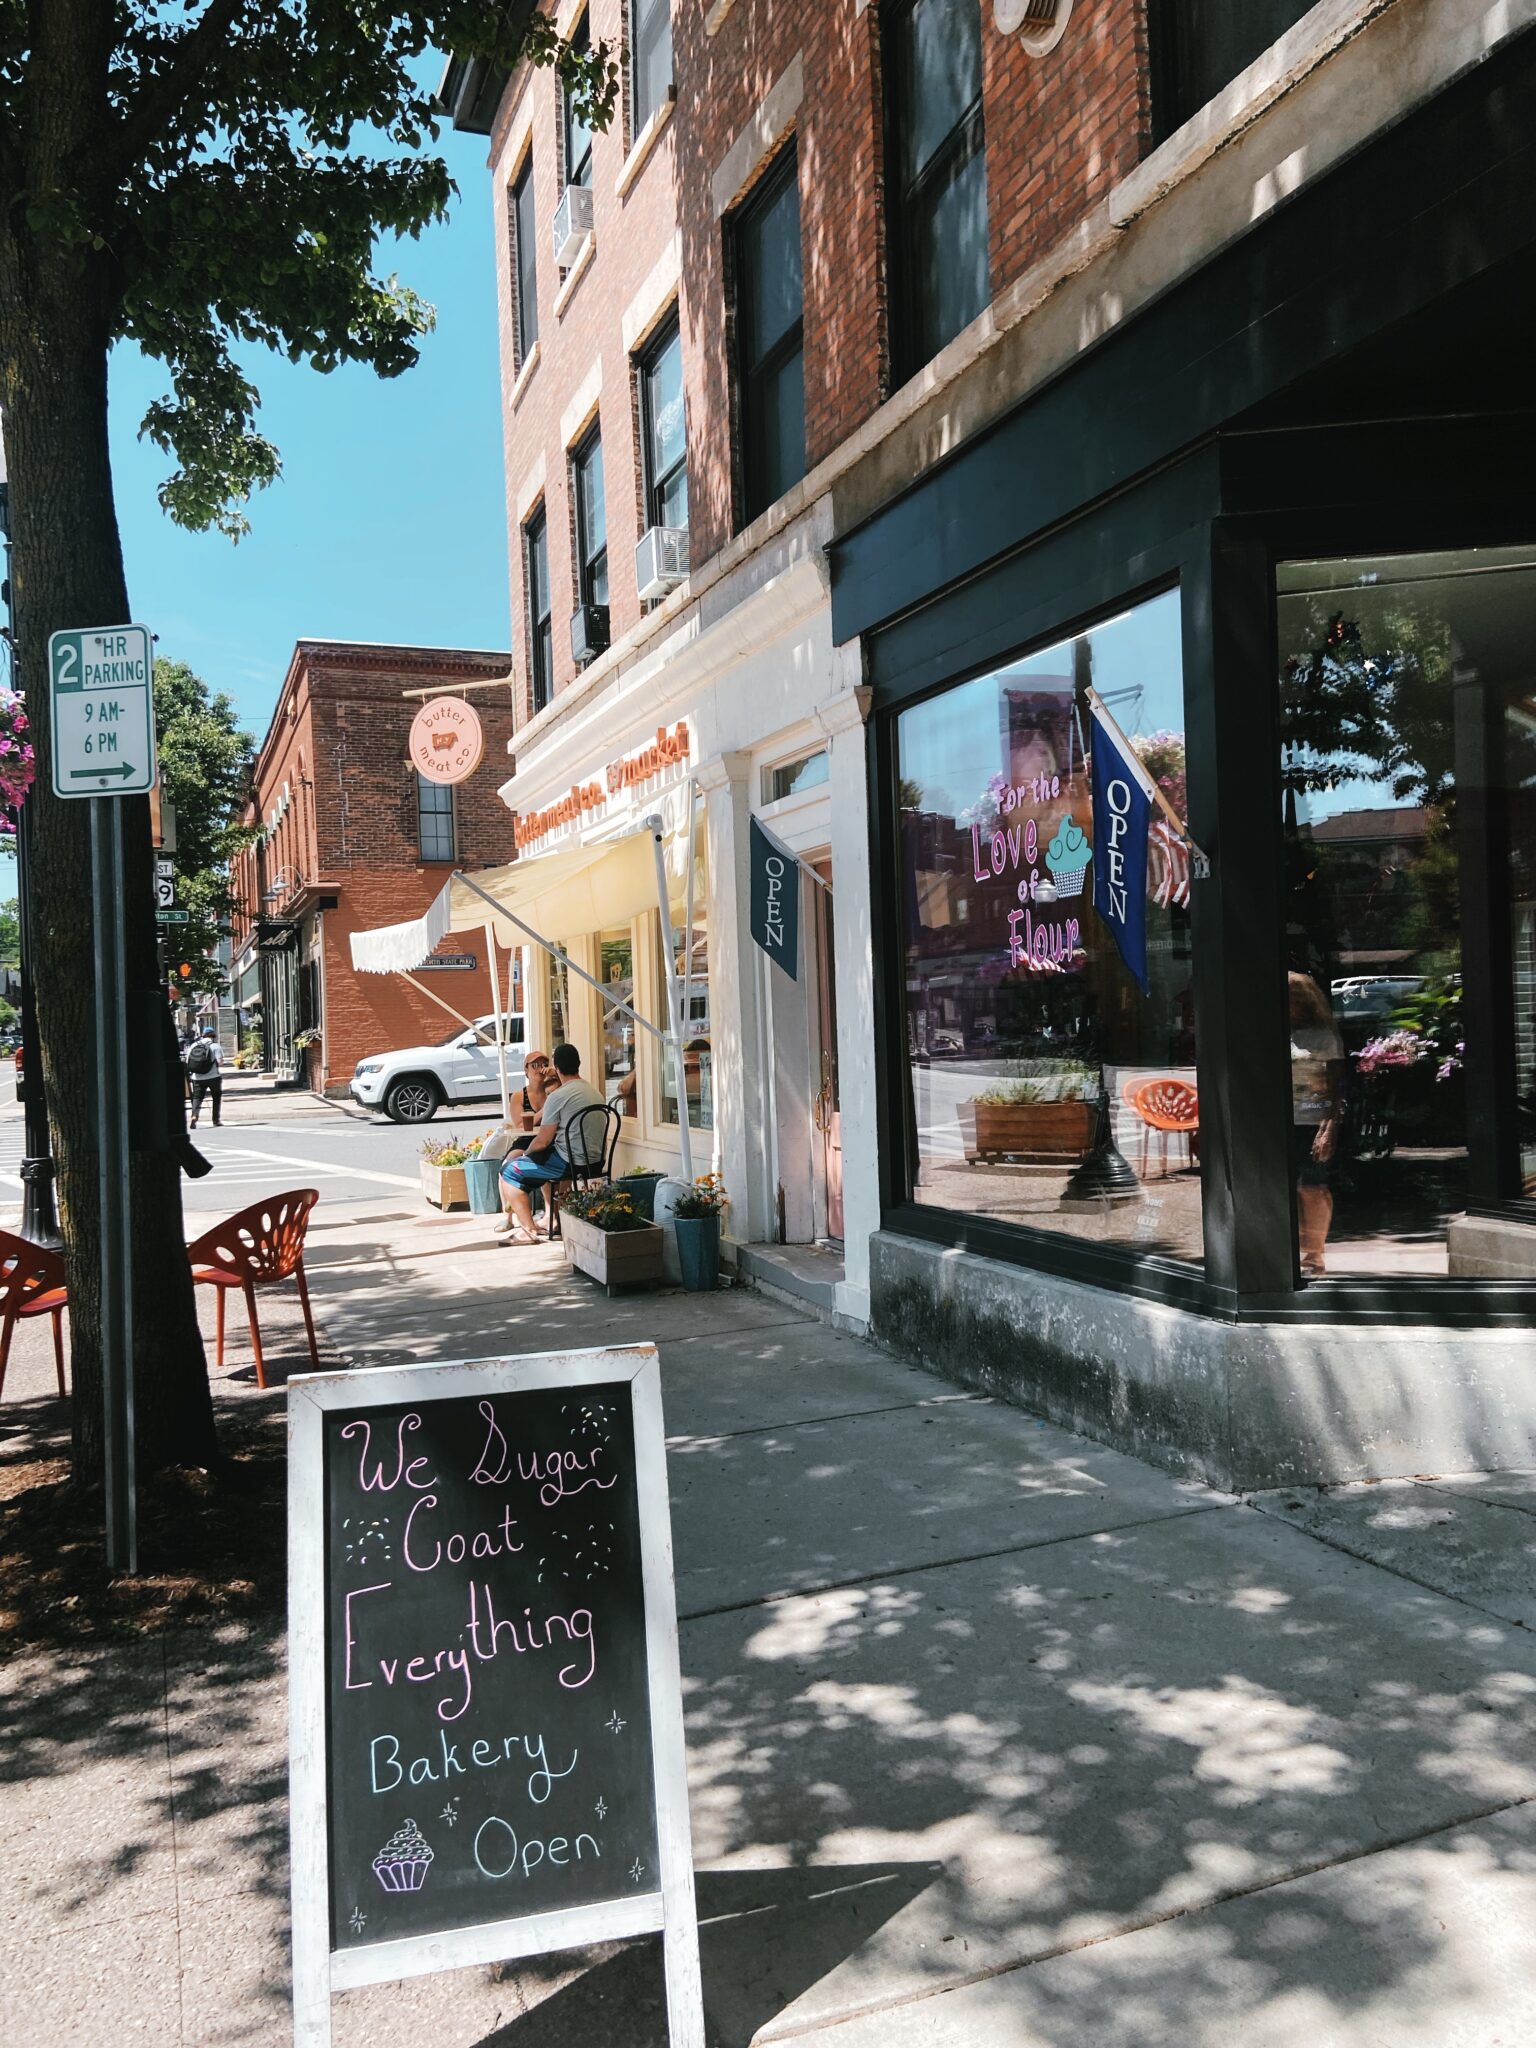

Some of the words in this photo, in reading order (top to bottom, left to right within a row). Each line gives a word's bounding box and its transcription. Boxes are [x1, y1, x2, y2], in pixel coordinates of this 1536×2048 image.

[56, 643, 79, 685] 2
[103, 636, 127, 658] HR
[84, 659, 145, 686] PARKING
[84, 703, 94, 723] 9
[421, 706, 467, 728] butter
[84, 733, 93, 754] 6
[98, 731, 118, 753] PM
[419, 746, 451, 772] meat
[993, 782, 1026, 816] For
[1030, 770, 1060, 804] the
[971, 818, 1038, 883] Love
[1106, 779, 1132, 925] OPEN
[159, 884, 172, 901] 9
[764, 856, 785, 947] OPEN
[1017, 868, 1040, 902] of
[1007, 908, 1079, 969] Flour
[341, 1412, 437, 1491] We
[467, 1400, 618, 1506] Sugar
[404, 1494, 524, 1571] Coat
[345, 1580, 596, 1721] Everything
[370, 1729, 578, 1803] Bakery
[474, 1816, 601, 1878] Open
